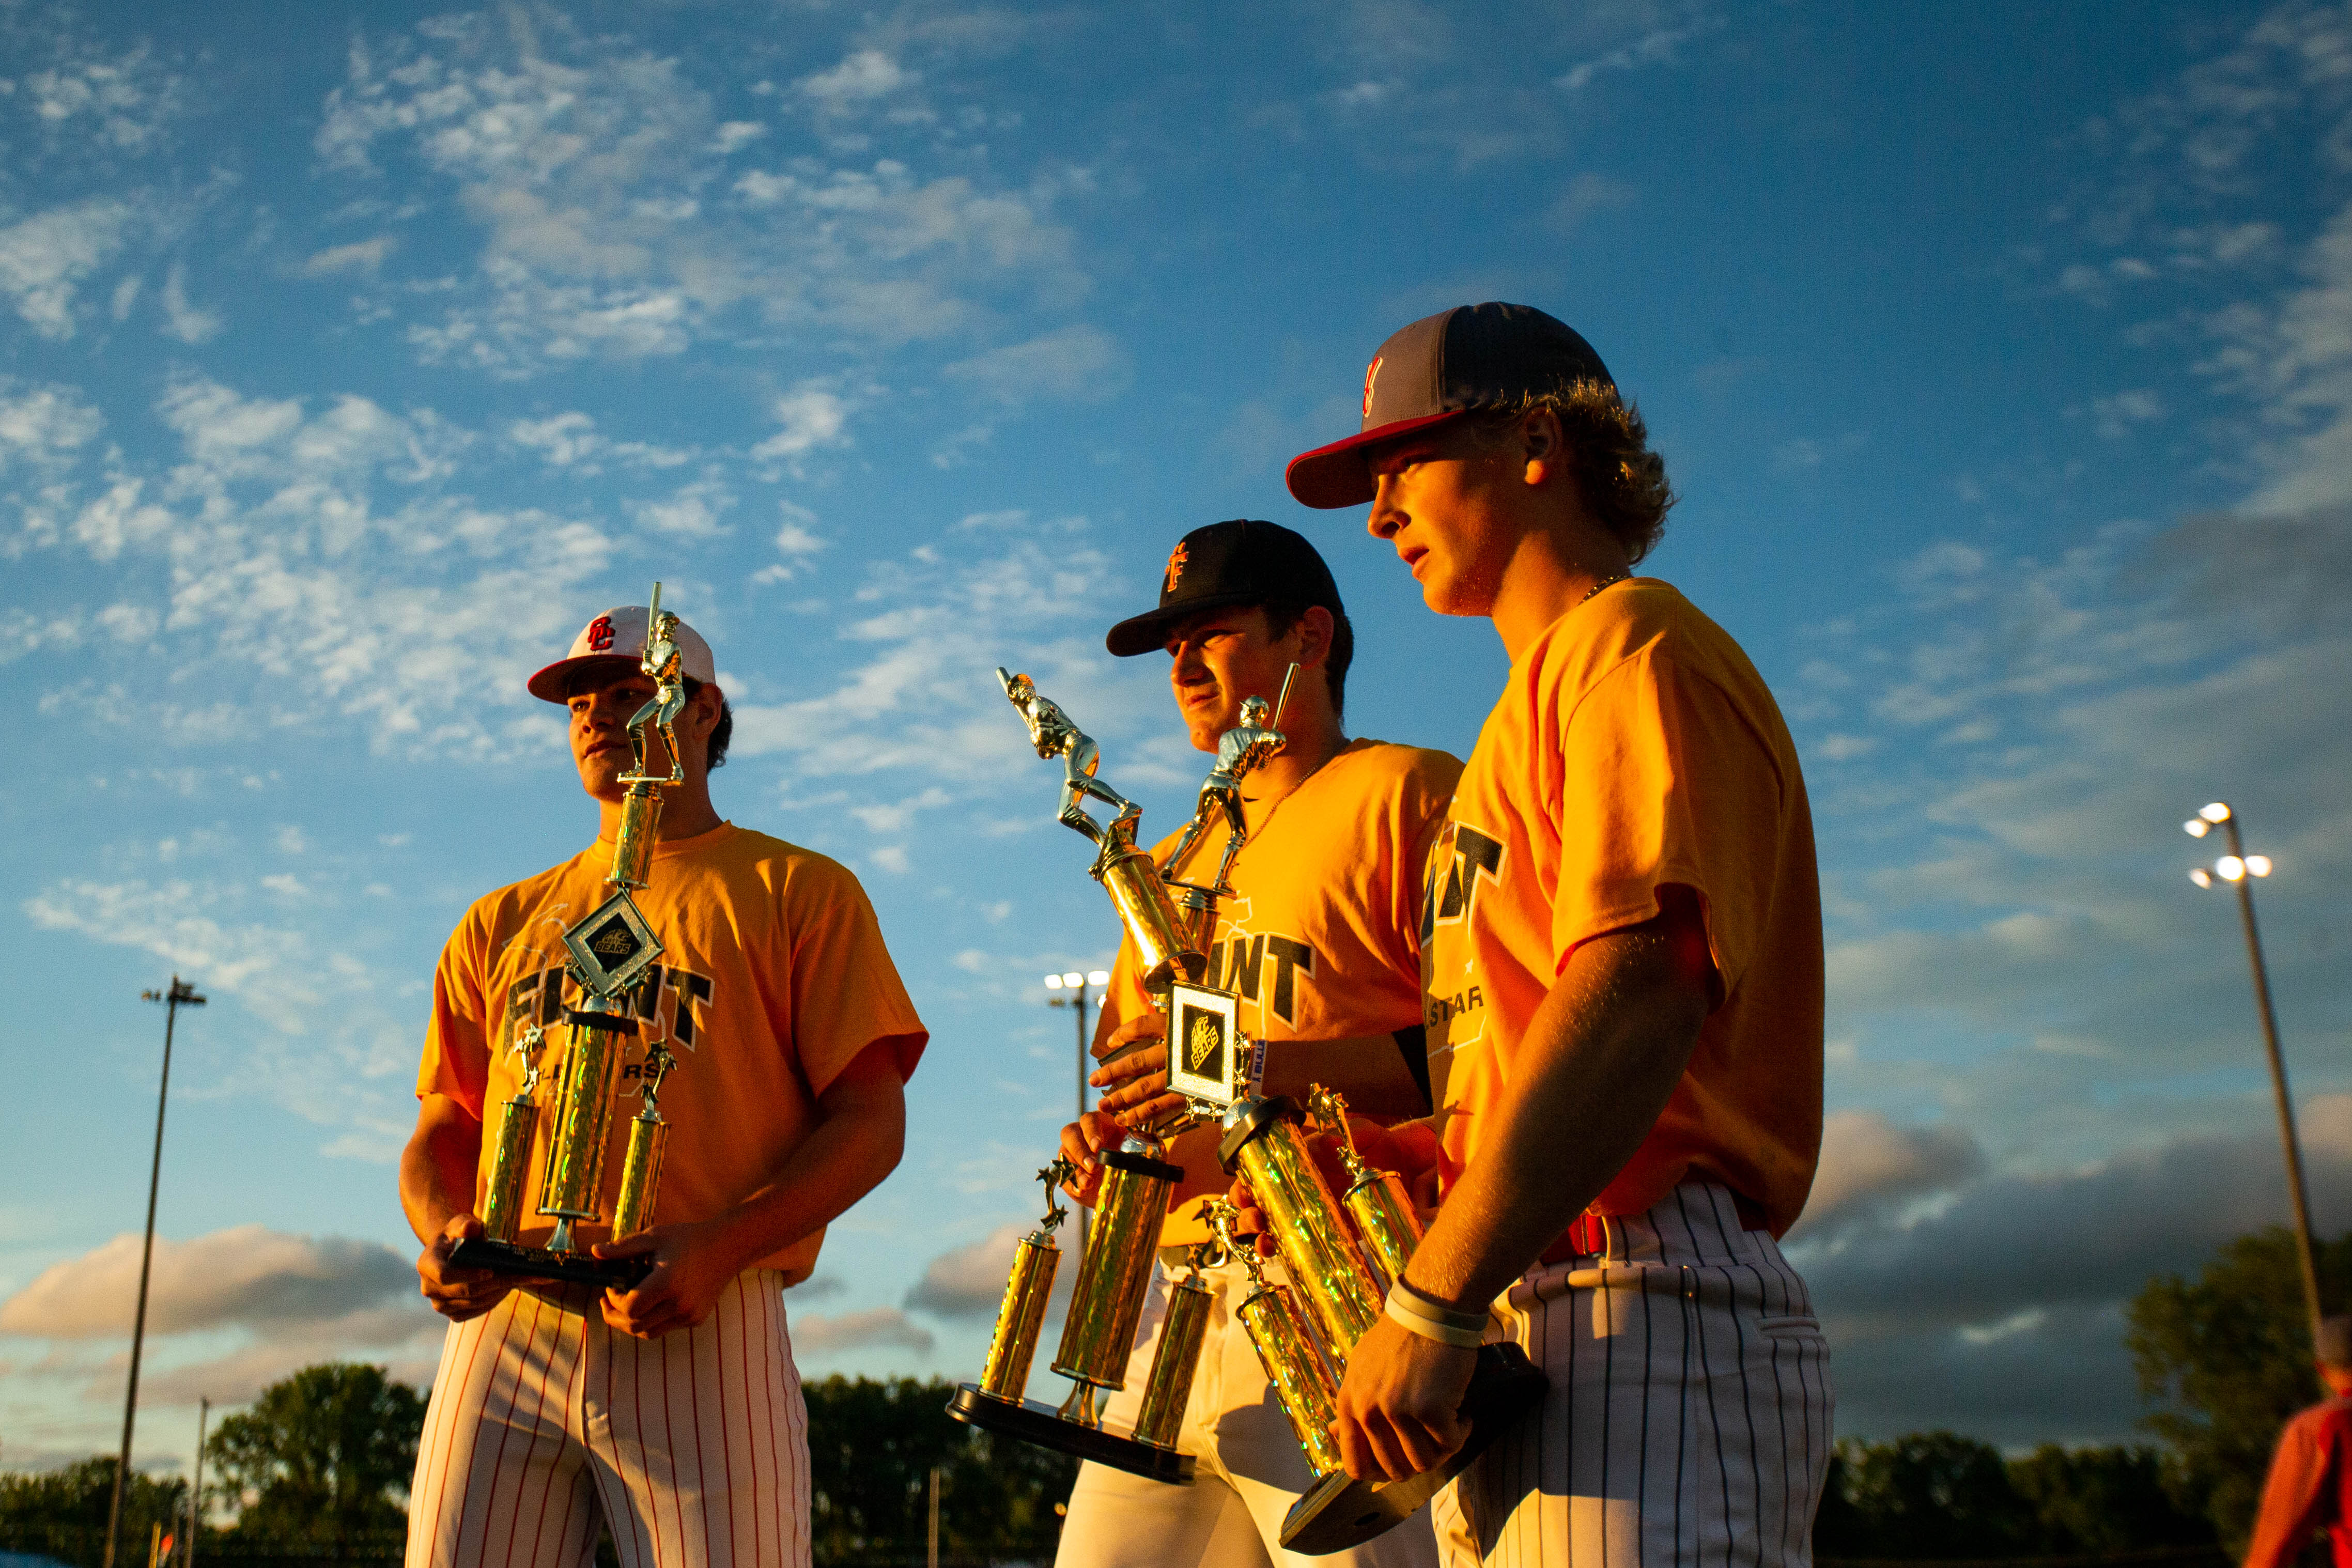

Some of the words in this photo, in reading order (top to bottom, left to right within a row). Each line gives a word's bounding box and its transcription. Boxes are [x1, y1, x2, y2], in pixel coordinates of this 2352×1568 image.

[596, 942, 629, 953] BEARS
[502, 961, 715, 1066] FLNT
[1193, 1029, 1218, 1067] BEARS
